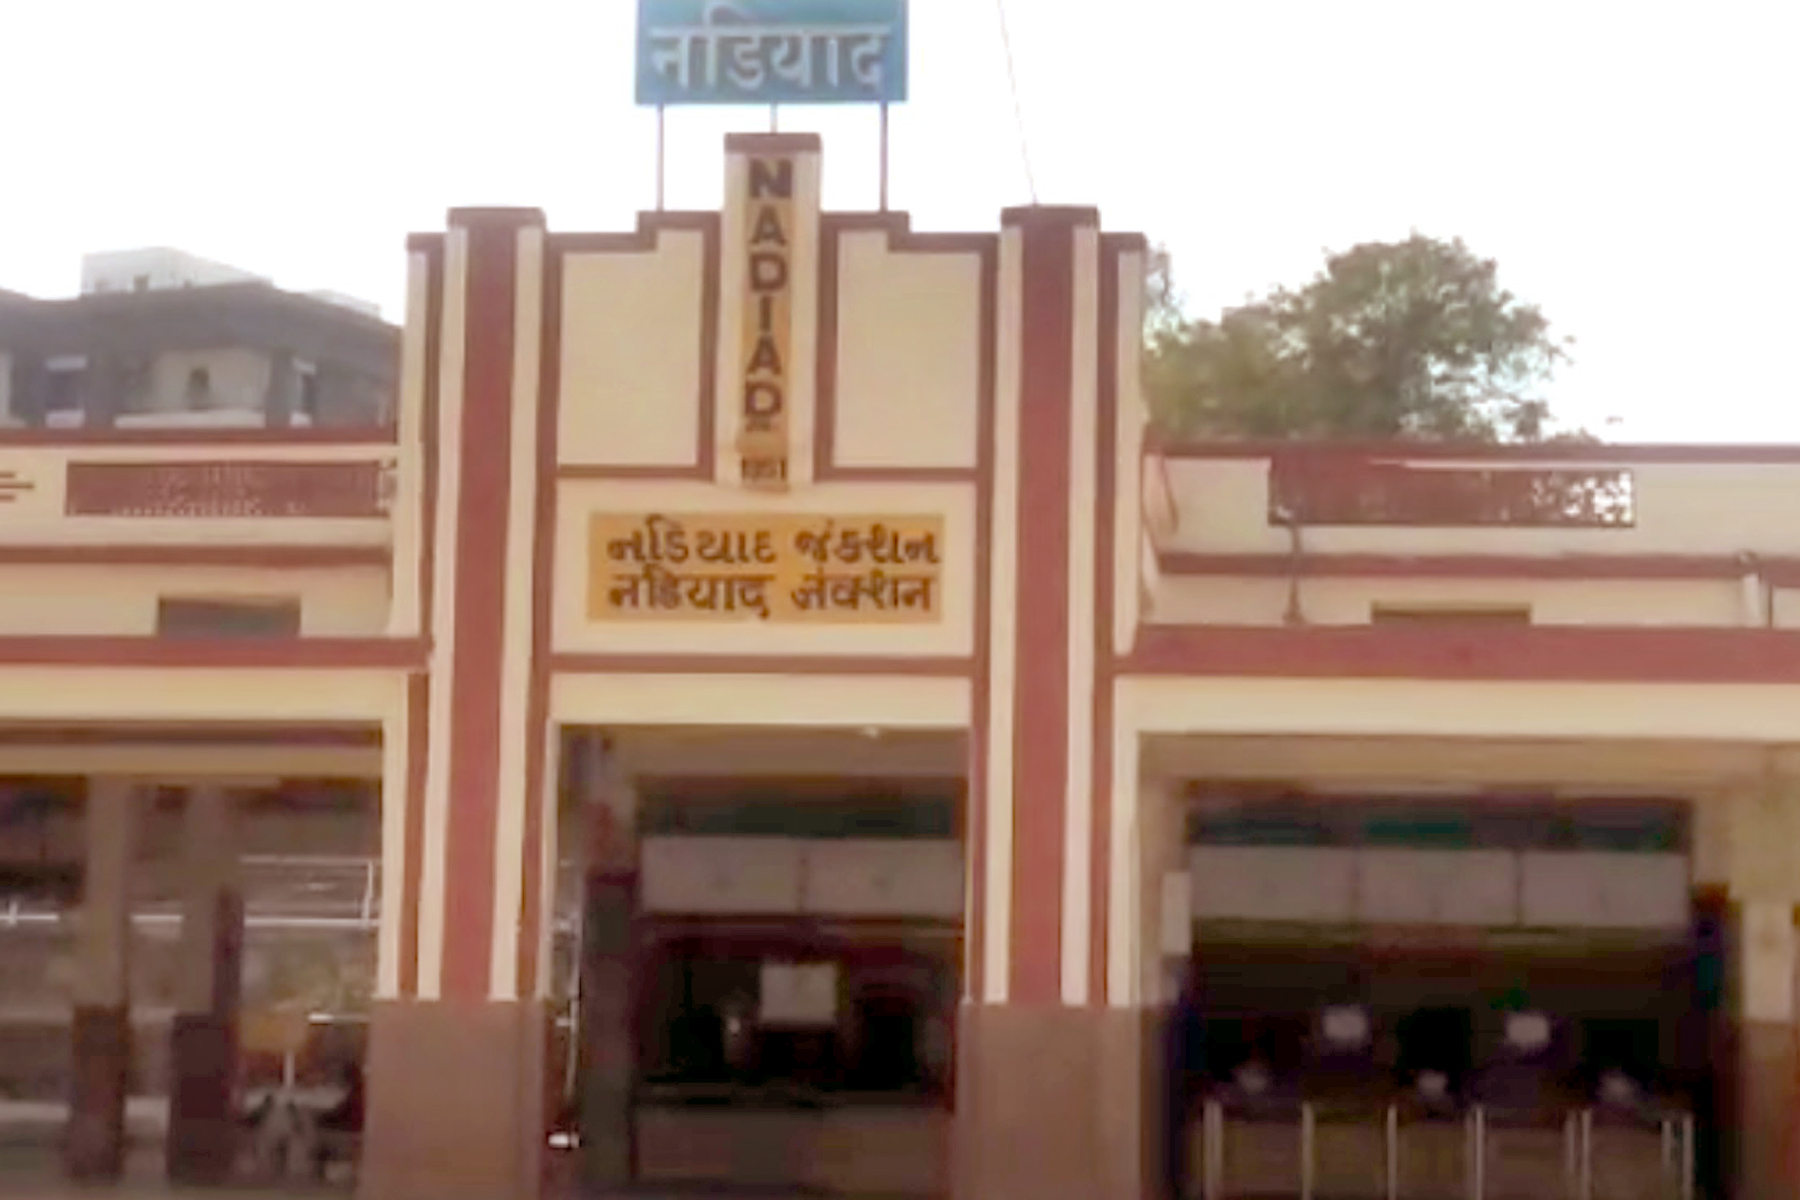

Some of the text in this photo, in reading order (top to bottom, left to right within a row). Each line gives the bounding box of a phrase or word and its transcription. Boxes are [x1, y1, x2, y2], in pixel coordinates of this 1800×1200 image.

[650, 2, 889, 90] नडियाद
[744, 157, 794, 416] NADIAD
[606, 513, 777, 563] નડિયાદ
[608, 564, 776, 619] नडियाद
